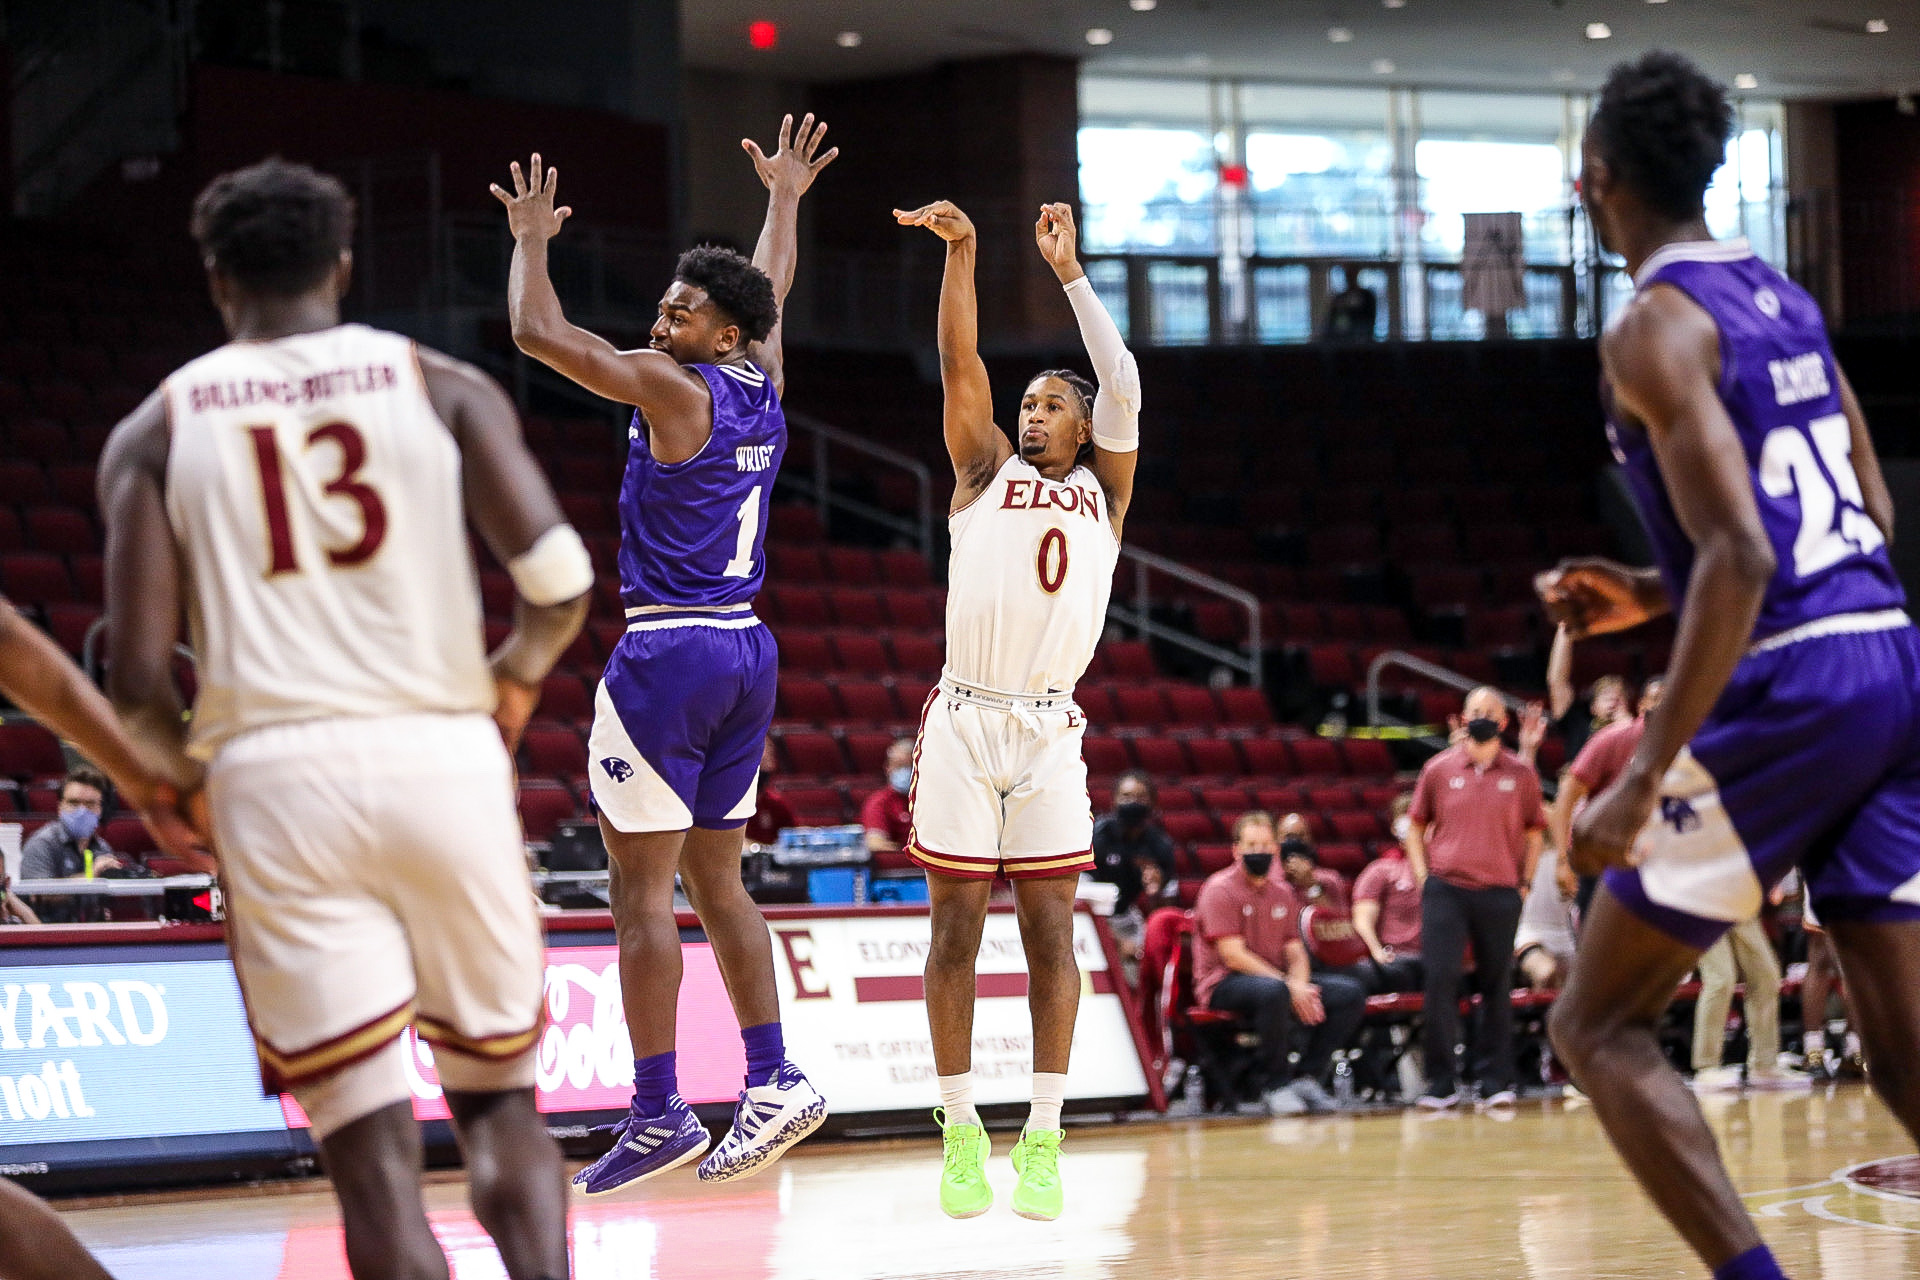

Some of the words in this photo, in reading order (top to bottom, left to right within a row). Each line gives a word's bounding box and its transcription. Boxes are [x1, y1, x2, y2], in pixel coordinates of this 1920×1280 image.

[247, 420, 389, 575] 13
[723, 485, 762, 578] 1
[1000, 479, 1099, 522] ELON
[1759, 413, 1886, 577] 25
[1036, 527, 1069, 595] 0
[1066, 711, 1080, 728] E
[774, 928, 832, 1002] E
